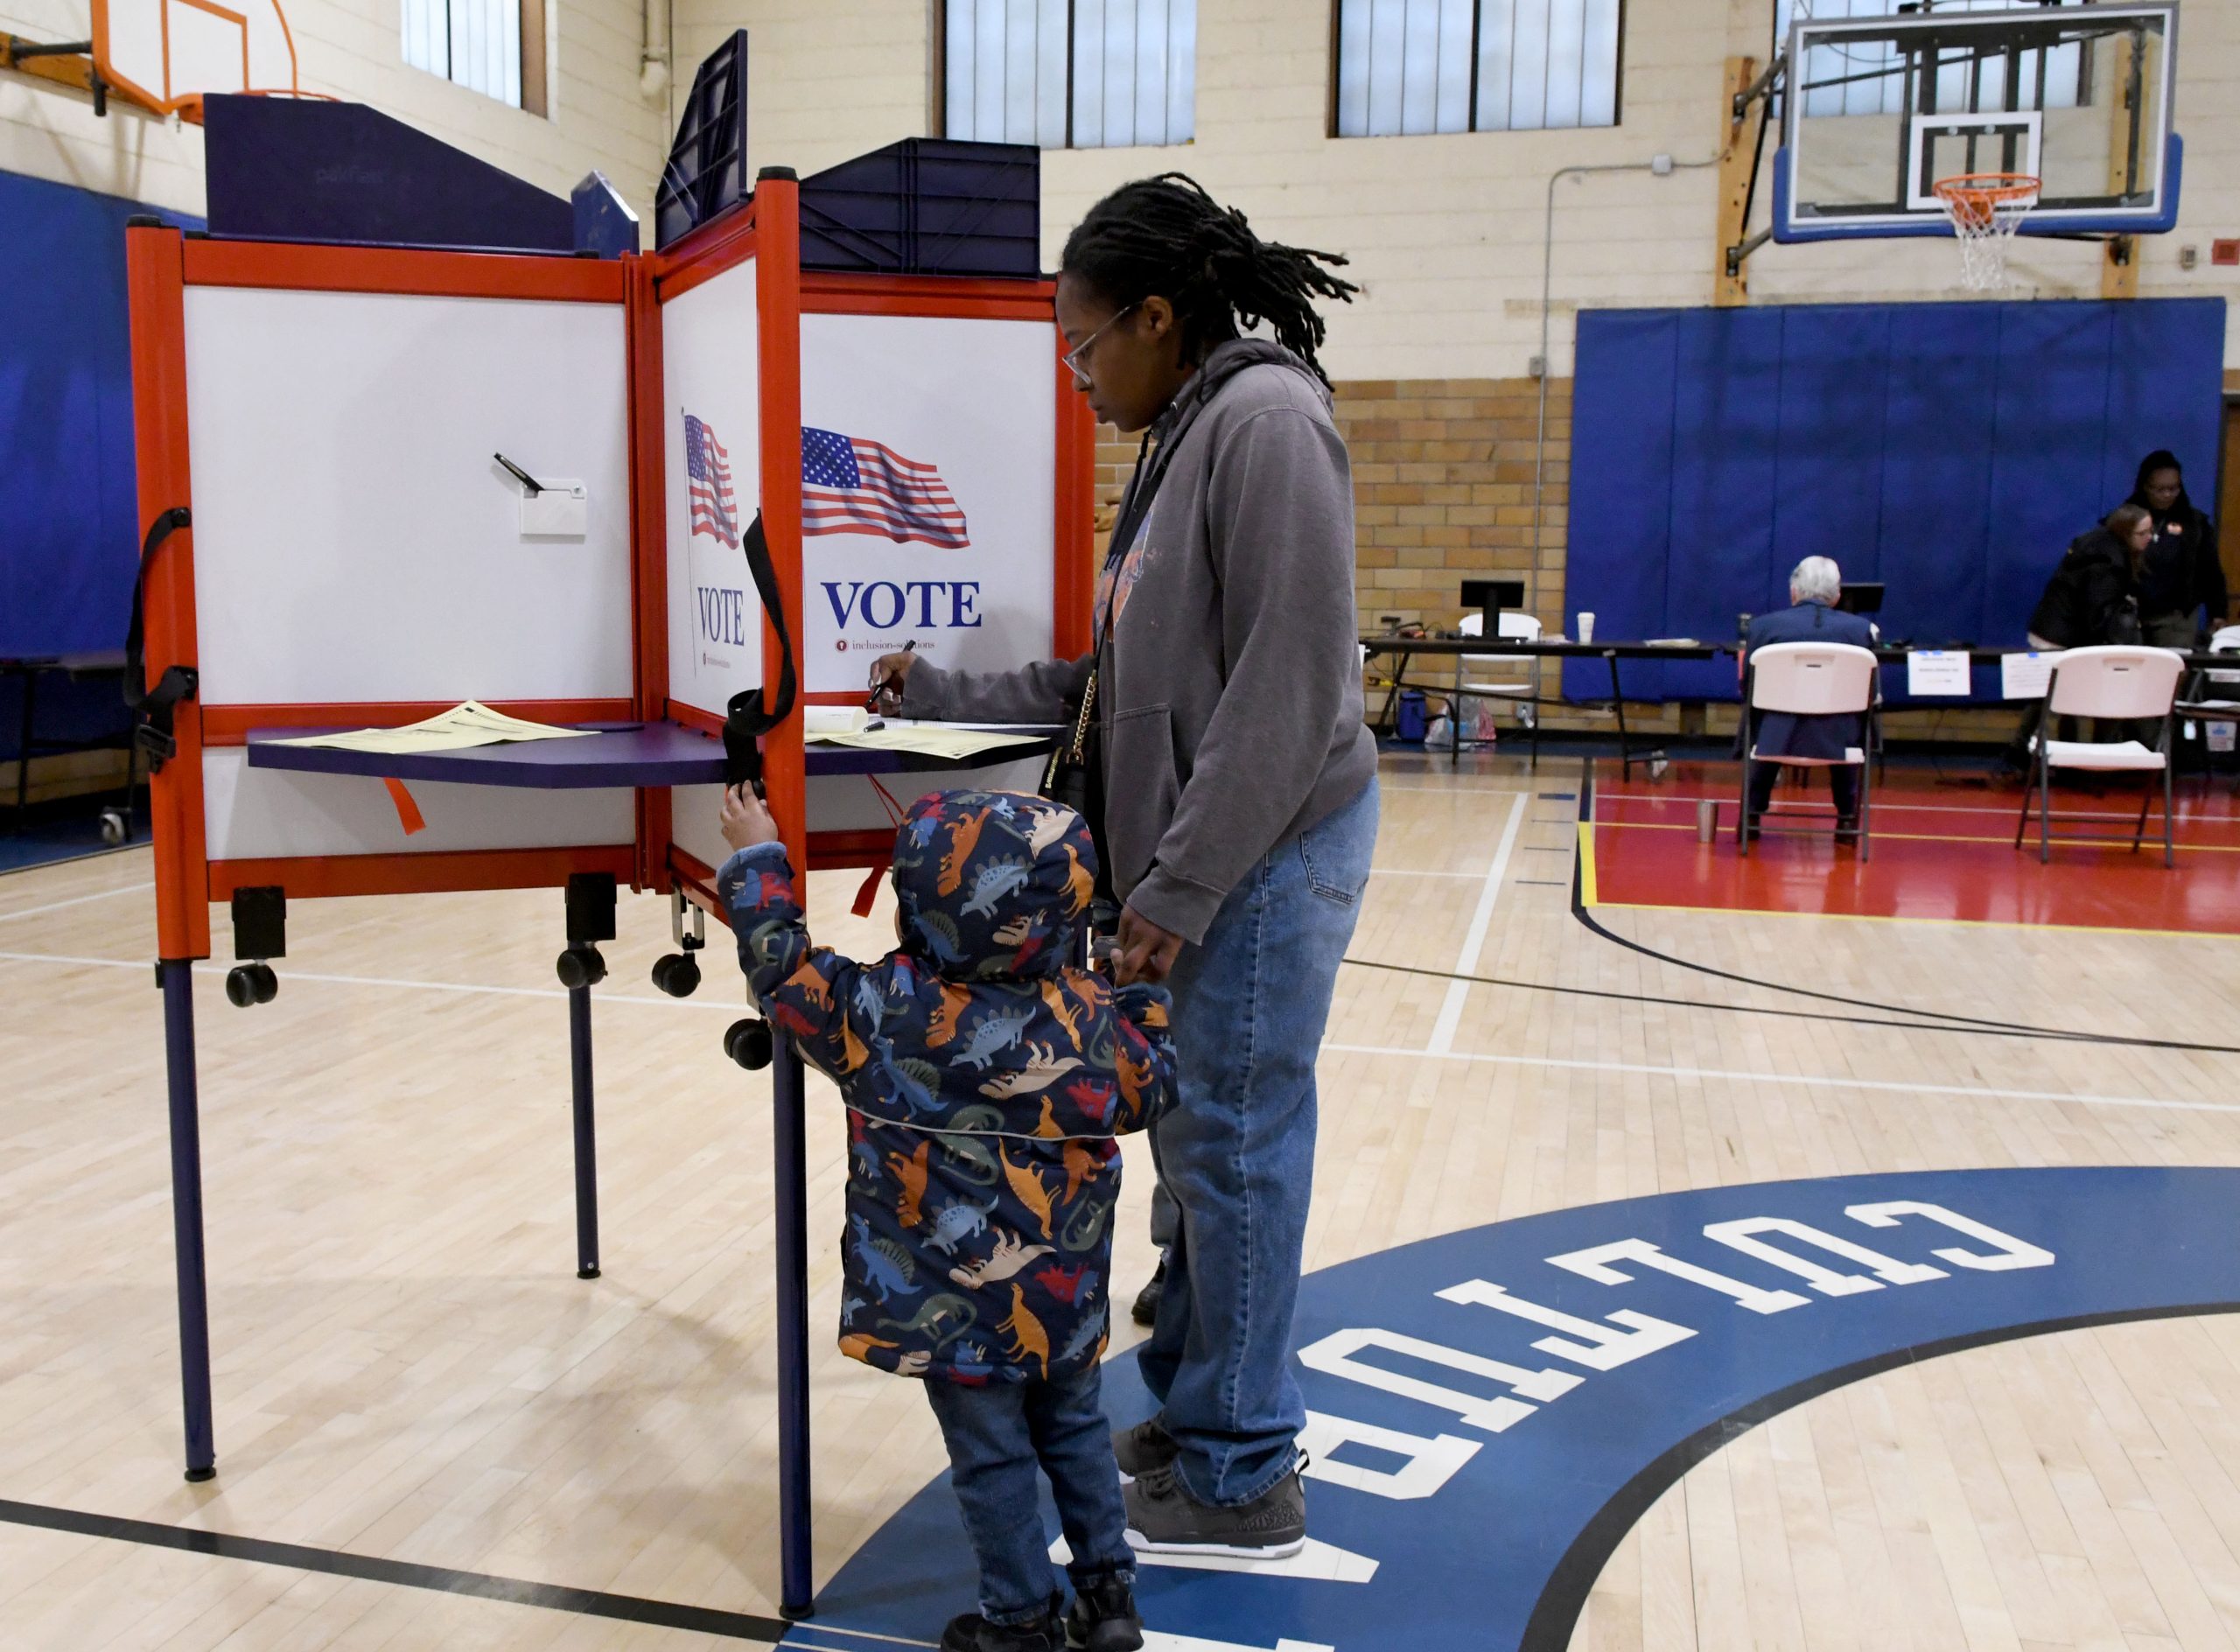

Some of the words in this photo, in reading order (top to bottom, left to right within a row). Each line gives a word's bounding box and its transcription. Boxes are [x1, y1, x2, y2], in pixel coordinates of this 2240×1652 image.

[697, 587, 745, 647] VOTE
[820, 581, 982, 629] VOTE
[851, 639, 935, 650] inclusion-soltions
[1048, 1200, 2055, 1652] CULTUR
